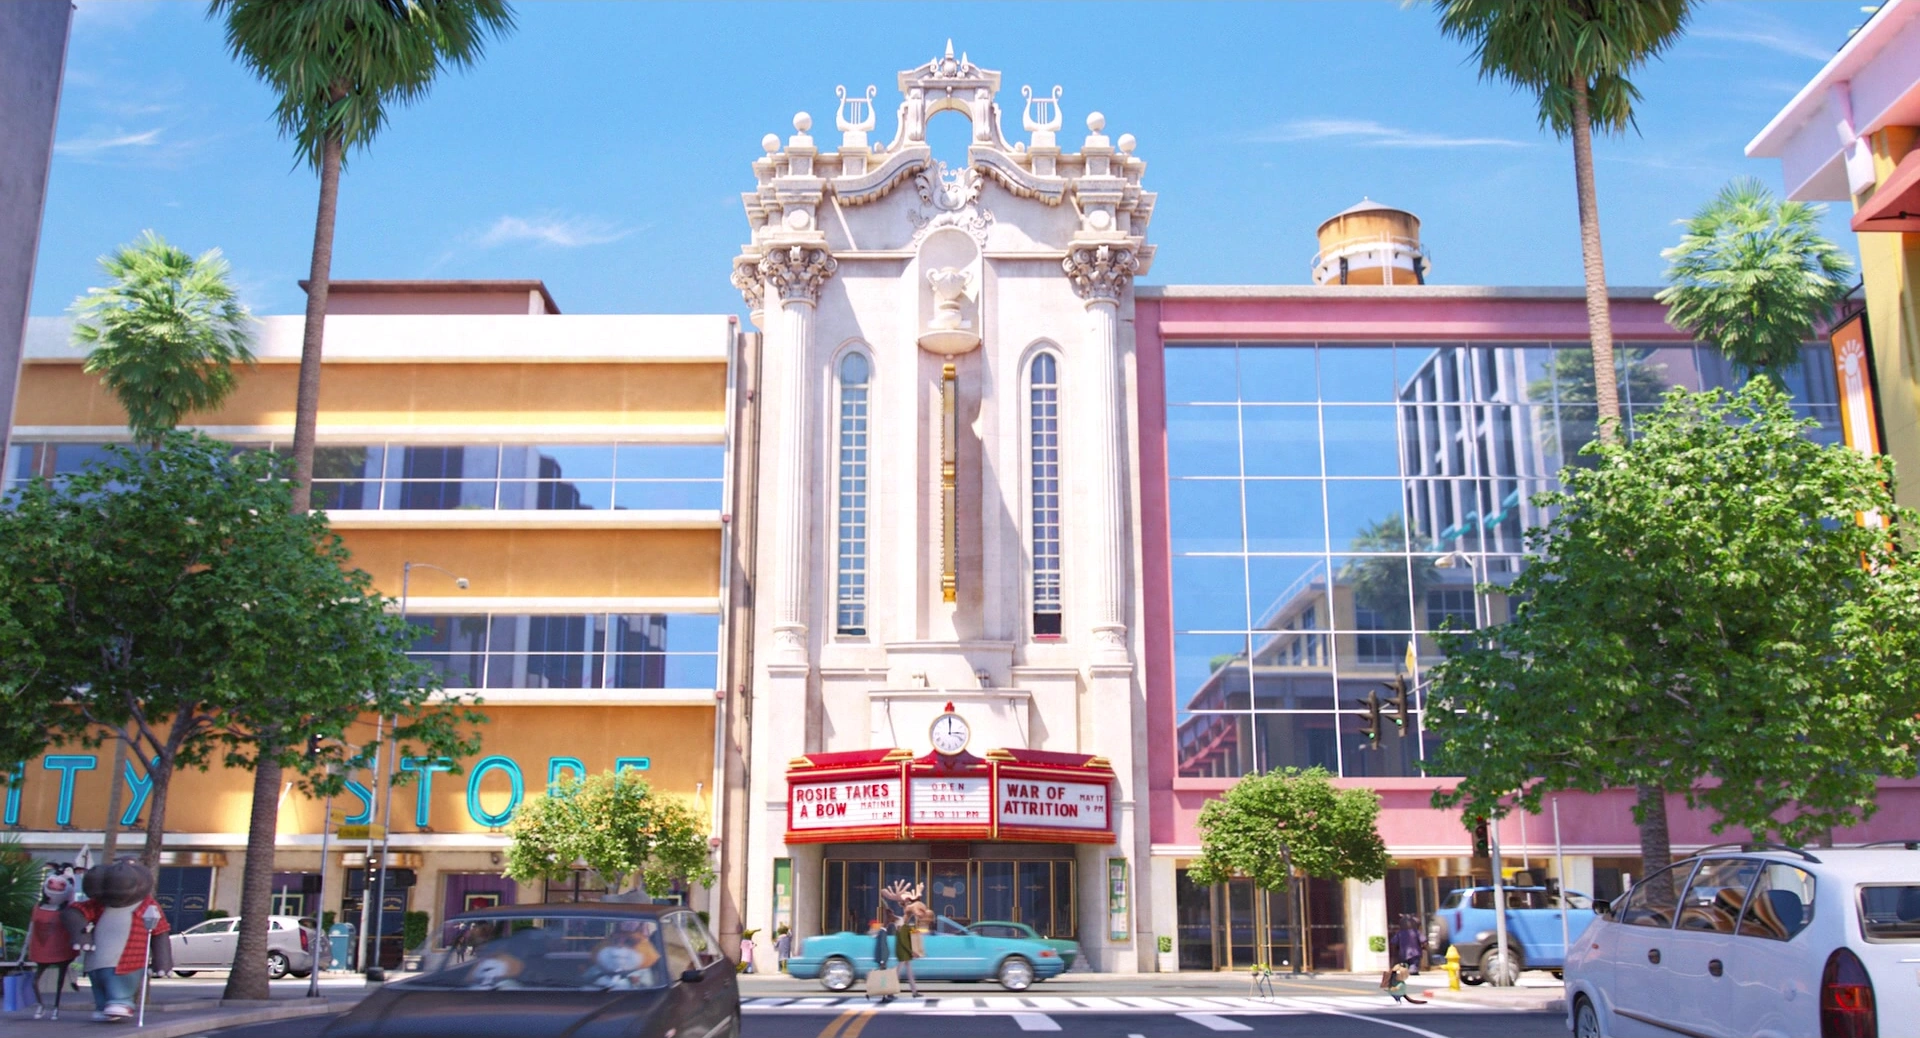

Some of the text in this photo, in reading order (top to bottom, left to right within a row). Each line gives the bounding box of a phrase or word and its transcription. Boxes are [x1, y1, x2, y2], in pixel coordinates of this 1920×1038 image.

[796, 783, 889, 802] ROSIE TAKES
[931, 783, 965, 791] OPEN
[1007, 783, 1066, 800] WAR OF
[932, 794, 965, 802] DAILY
[800, 802, 847, 818] A BOW
[860, 800, 895, 809] MATINEE
[1003, 800, 1078, 818] ATTRITION
[882, 811, 893, 819] AM
